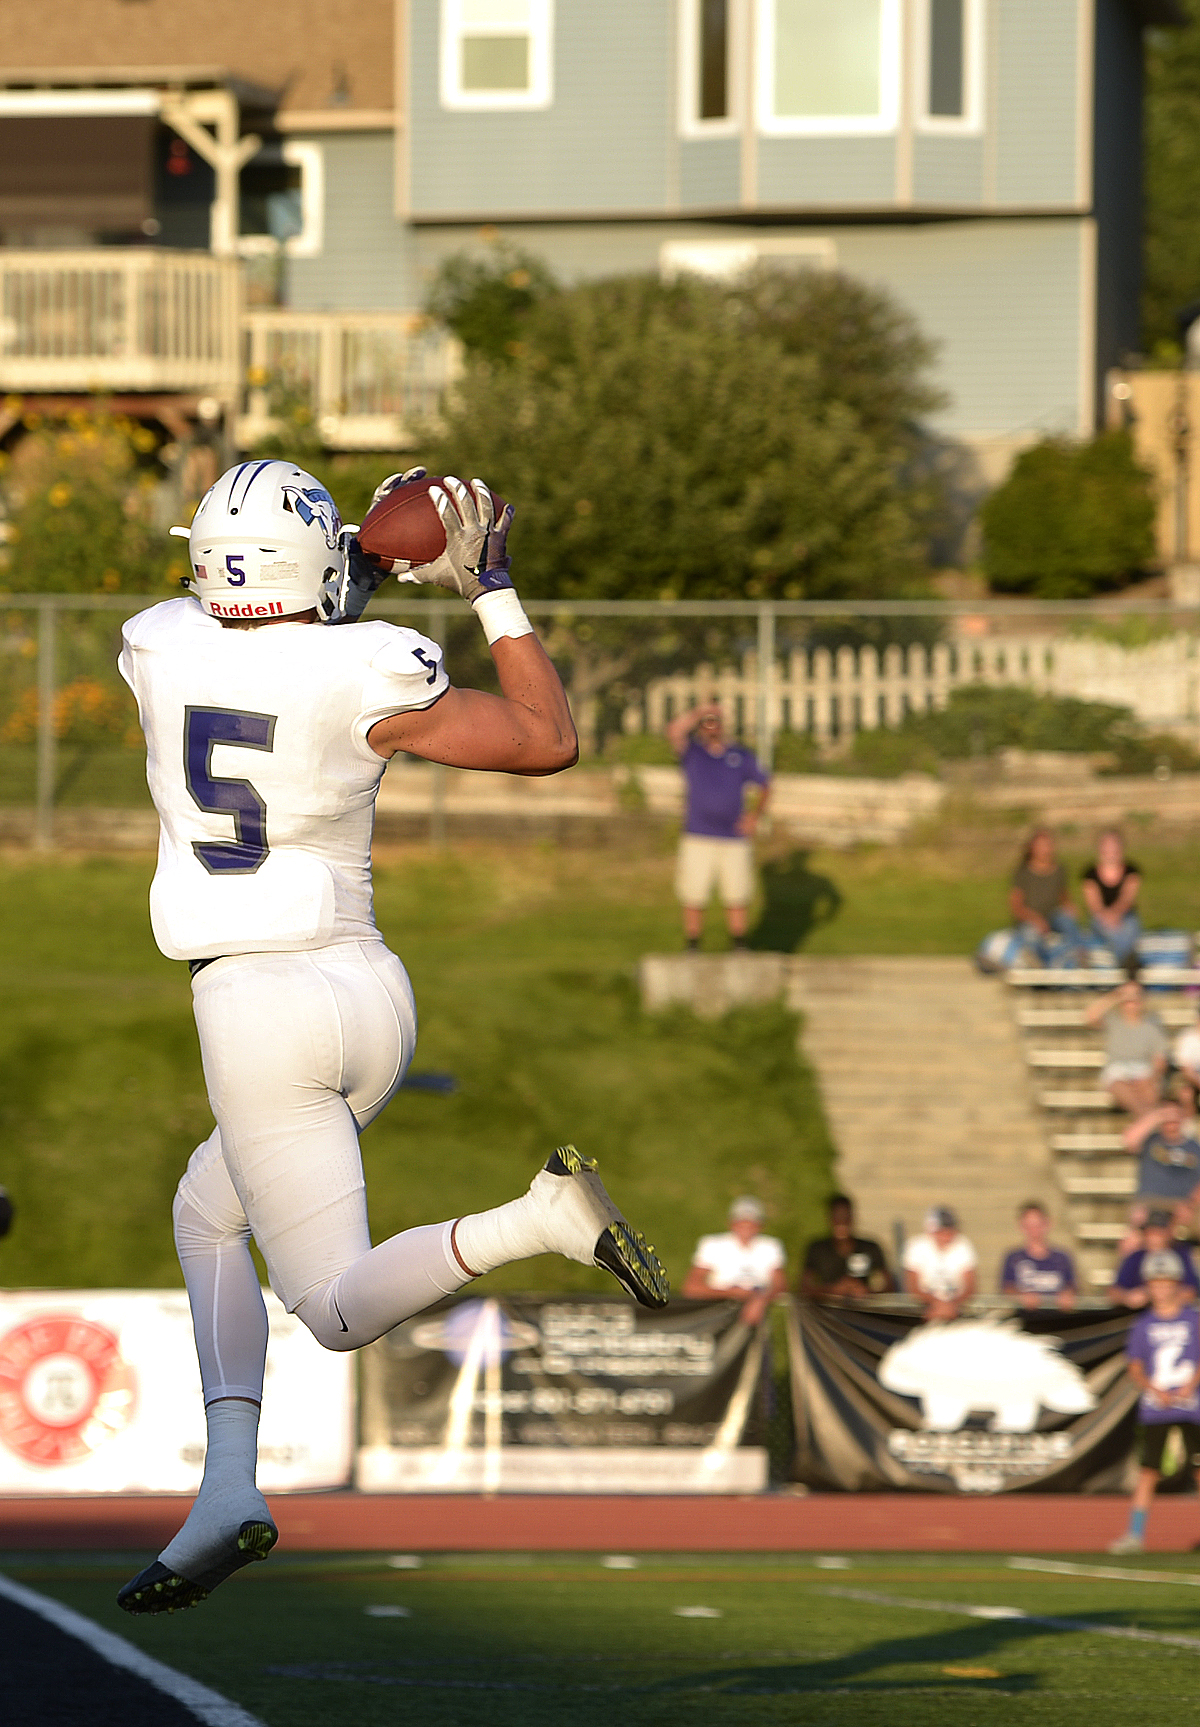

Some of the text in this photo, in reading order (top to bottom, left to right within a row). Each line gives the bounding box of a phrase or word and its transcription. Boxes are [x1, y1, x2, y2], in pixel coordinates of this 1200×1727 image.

[225, 554, 246, 587] 5
[208, 601, 284, 617] Riddell
[410, 647, 438, 686] 5
[182, 704, 279, 876] 5
